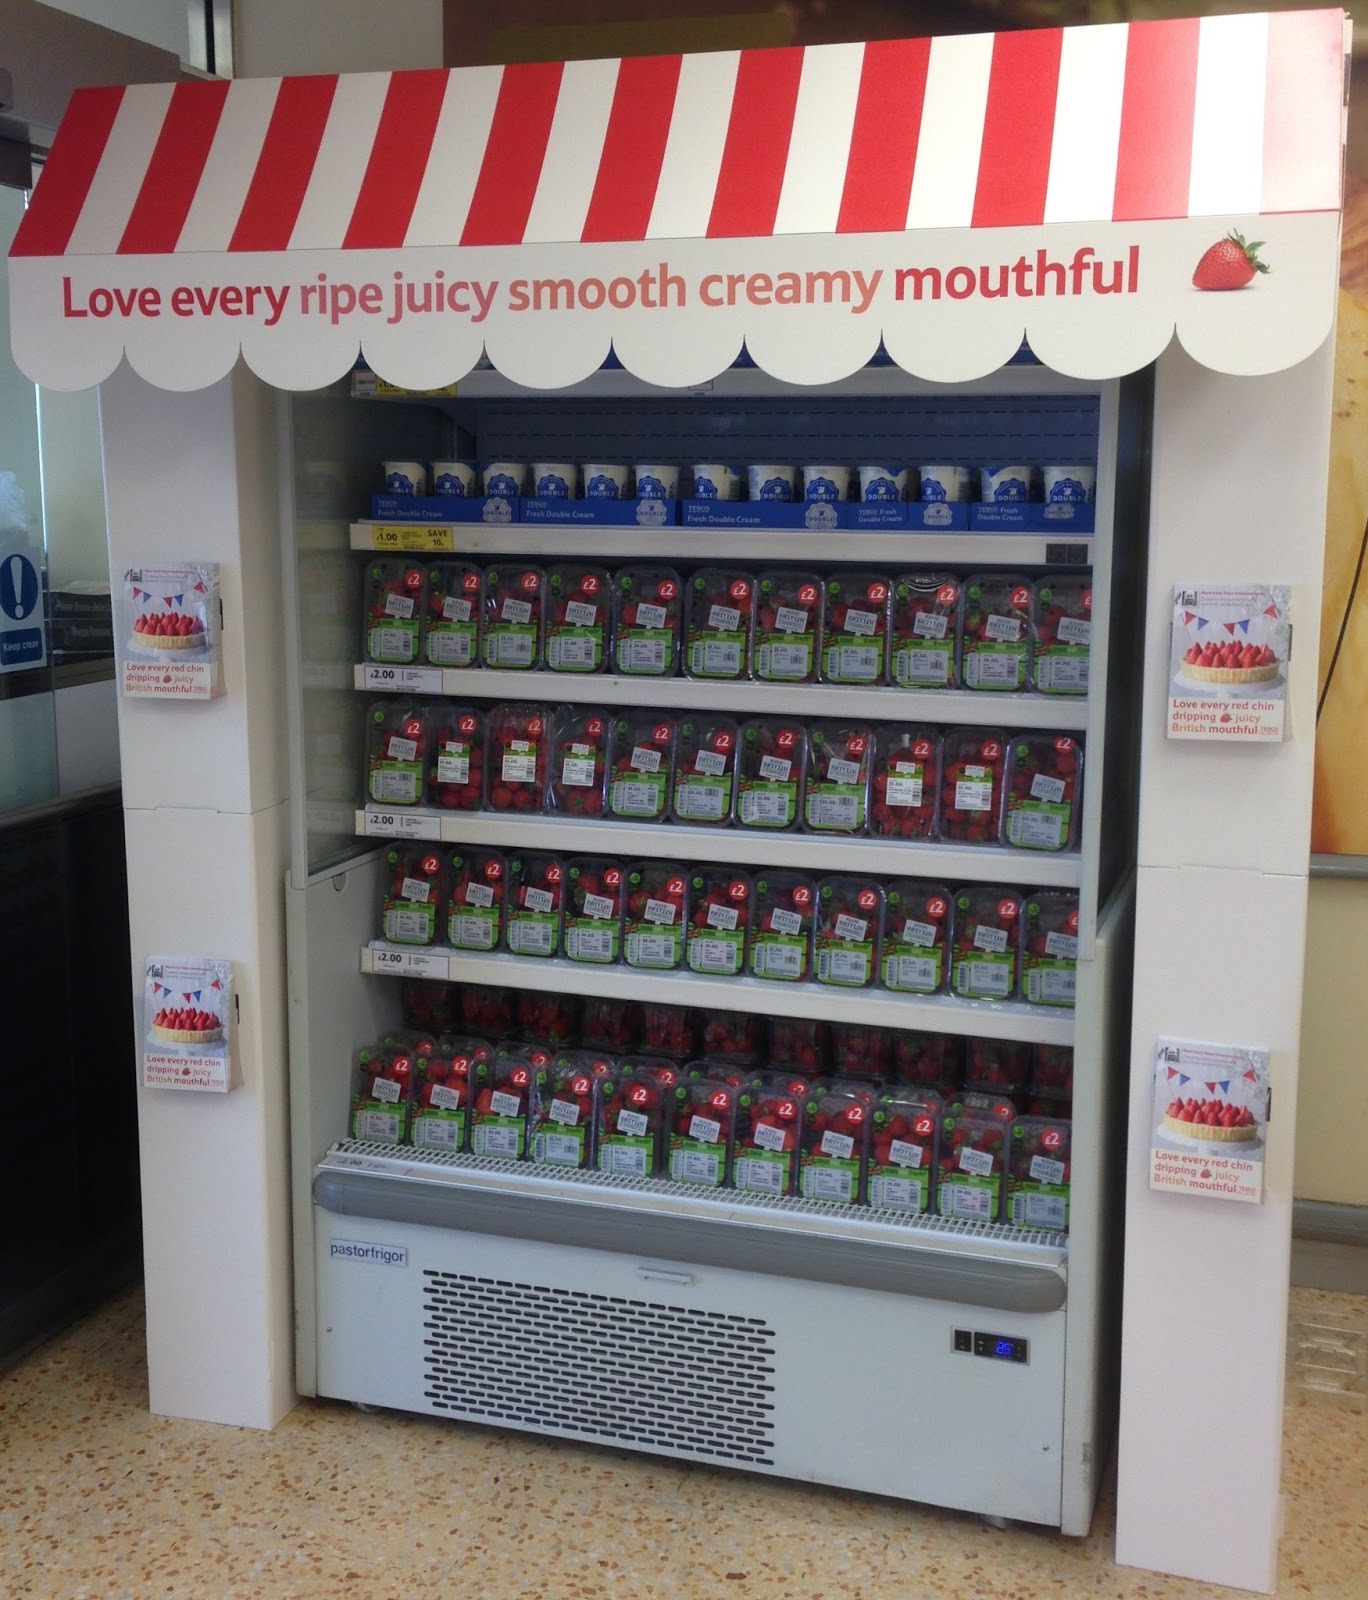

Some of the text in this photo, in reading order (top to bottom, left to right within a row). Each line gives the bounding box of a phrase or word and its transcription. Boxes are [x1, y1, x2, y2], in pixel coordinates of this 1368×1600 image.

[63, 244, 1140, 327] Love every ripe juicy smooth creamy mouthful
[688, 505, 710, 513] TESCO
[408, 574, 420, 584] £2
[465, 577, 477, 588] £2
[524, 576, 537, 587] £2
[583, 579, 596, 589] £2
[660, 585, 673, 595] £2
[733, 584, 746, 595] £2
[801, 589, 814, 599] £2
[870, 587, 884, 598] £2
[940, 589, 954, 600] £2
[1014, 592, 1027, 603] £2
[3, 640, 39, 652] Keep clear
[127, 663, 145, 671] Love
[186, 664, 204, 672] chin
[126, 674, 160, 683] dripping
[126, 682, 152, 692] British
[1174, 700, 1197, 708] Love
[1201, 702, 1229, 711] every
[1252, 702, 1274, 710] chin
[1173, 711, 1261, 724] dripping juicy
[408, 723, 419, 733] £2
[462, 719, 474, 729] £2
[528, 720, 541, 731] £2
[589, 722, 601, 732] £2
[1172, 723, 1205, 732] British
[1209, 726, 1257, 734] mouthful
[655, 728, 668, 739] £2
[779, 733, 792, 744] £2
[716, 735, 729, 746] £2
[850, 739, 863, 750] £2
[1057, 738, 1070, 748] £2
[915, 743, 928, 754] £2
[984, 745, 998, 755] £2
[424, 859, 437, 870] £2
[488, 864, 499, 875] £2
[548, 869, 560, 879] £2
[607, 872, 619, 883] £2
[669, 882, 682, 892] £2
[731, 885, 744, 896] £2
[796, 890, 808, 901] £2
[861, 894, 874, 905] £2
[930, 902, 943, 912] £2
[1001, 903, 1015, 914] £2
[147, 1055, 165, 1063] Love
[167, 1057, 188, 1065] every
[205, 1058, 220, 1066] chin
[396, 1060, 408, 1071] £2
[454, 1060, 467, 1071] £2
[147, 1066, 211, 1077] dripping juicy
[514, 1072, 526, 1082] £2
[147, 1075, 172, 1083] British
[575, 1080, 587, 1091] £2
[633, 1090, 646, 1101] £2
[713, 1094, 726, 1105] £2
[779, 1104, 792, 1115] £2
[848, 1108, 862, 1120] £2
[917, 1120, 930, 1132] £2
[1045, 1133, 1059, 1144] £2
[1156, 1150, 1252, 1171] Love every red chin
[1155, 1162, 1239, 1182] dripping juicy
[1154, 1174, 1186, 1186] British
[1190, 1180, 1236, 1192] mouthful
[330, 1244, 404, 1263] pastorfrigor
